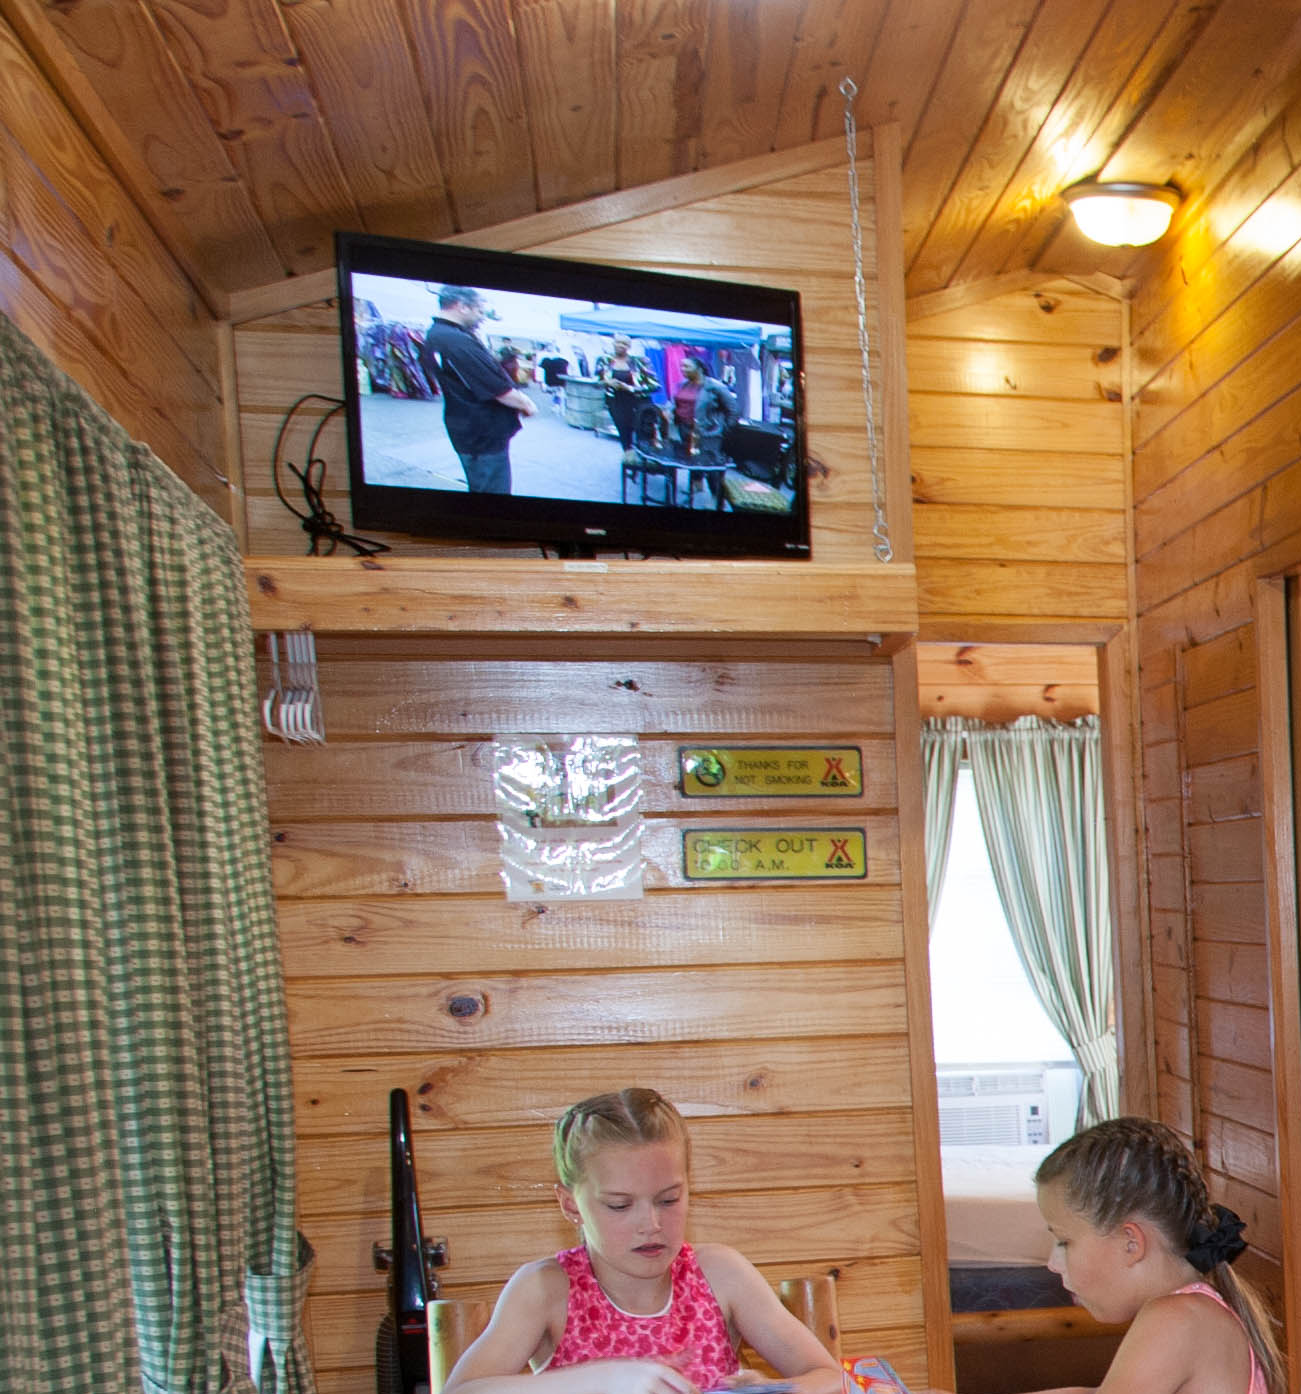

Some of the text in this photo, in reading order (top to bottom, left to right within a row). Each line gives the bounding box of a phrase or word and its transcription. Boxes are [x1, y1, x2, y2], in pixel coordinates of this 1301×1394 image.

[737, 760, 809, 770] THANKS FOR
[734, 775, 812, 785] NOT SMOKING
[776, 838, 819, 854] OUT
[755, 859, 790, 871] A.M.
